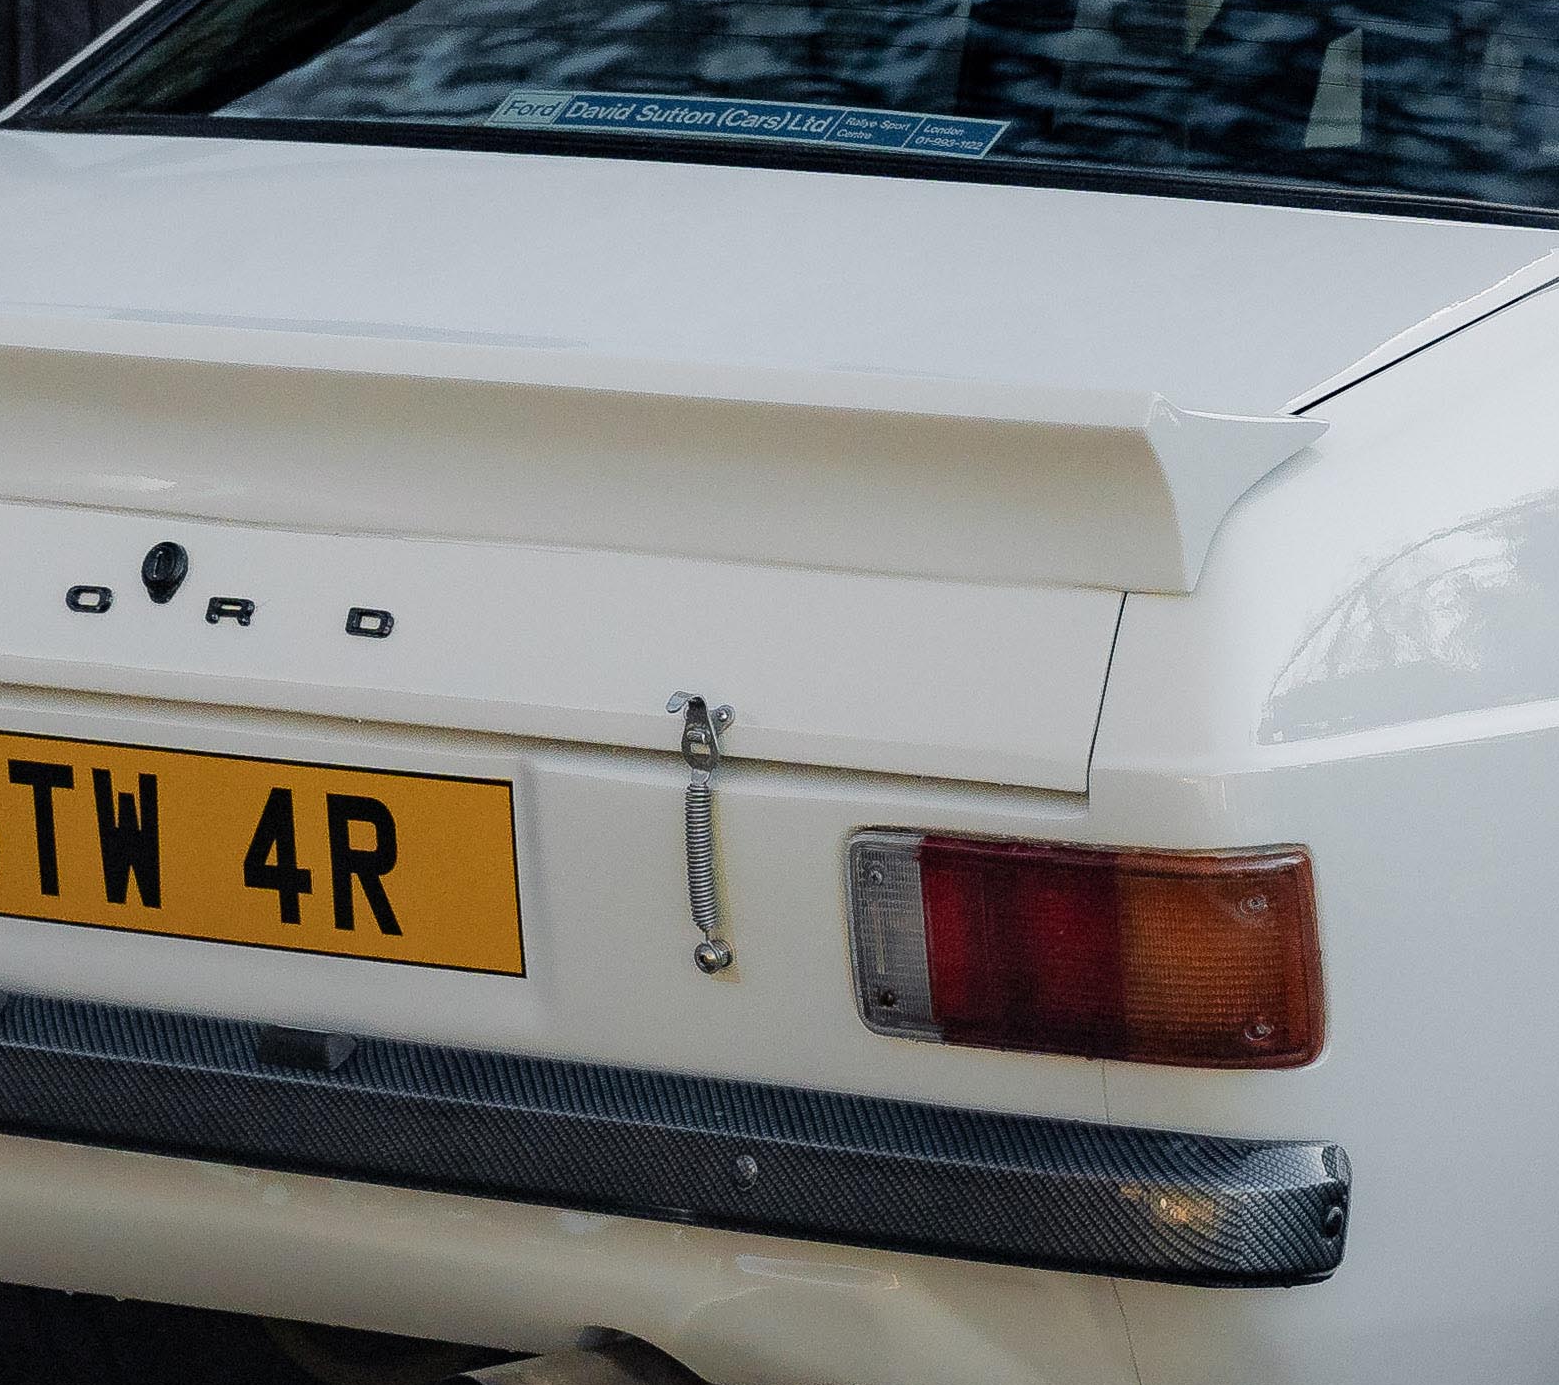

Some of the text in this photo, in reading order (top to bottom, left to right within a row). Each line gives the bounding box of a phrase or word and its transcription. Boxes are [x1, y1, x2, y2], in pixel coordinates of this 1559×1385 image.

[506, 100, 561, 116] Ford
[566, 102, 833, 134] David Sutton (Cars) Ltd
[879, 119, 912, 132] Sport
[923, 123, 965, 137] London
[836, 127, 873, 140] Centre
[915, 136, 984, 150] 01-993-1122
[243, 786, 403, 937] 4R
